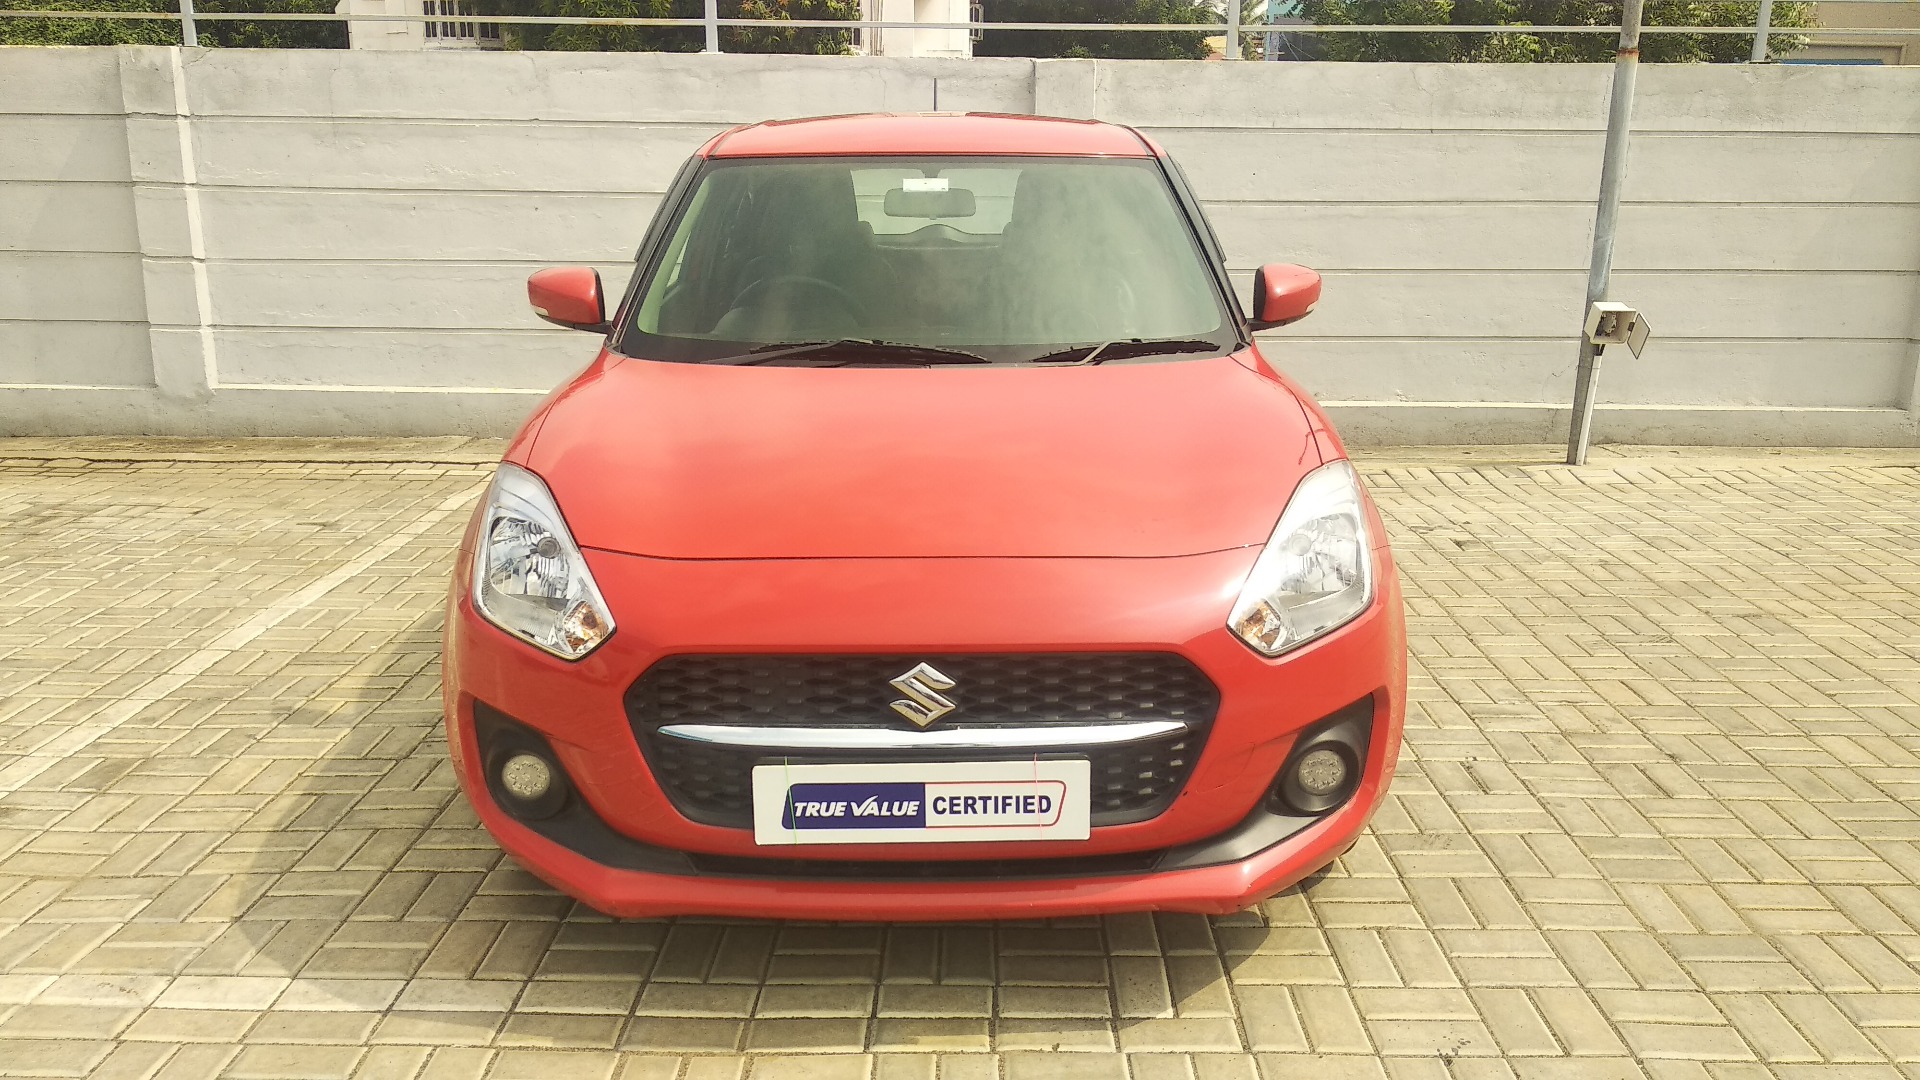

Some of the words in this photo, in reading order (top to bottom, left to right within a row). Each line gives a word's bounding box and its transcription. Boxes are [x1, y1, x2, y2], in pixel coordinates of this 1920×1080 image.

[794, 801, 848, 817] TRUE
[850, 794, 920, 817] VALUE
[932, 794, 1052, 815] CERTIFIED
